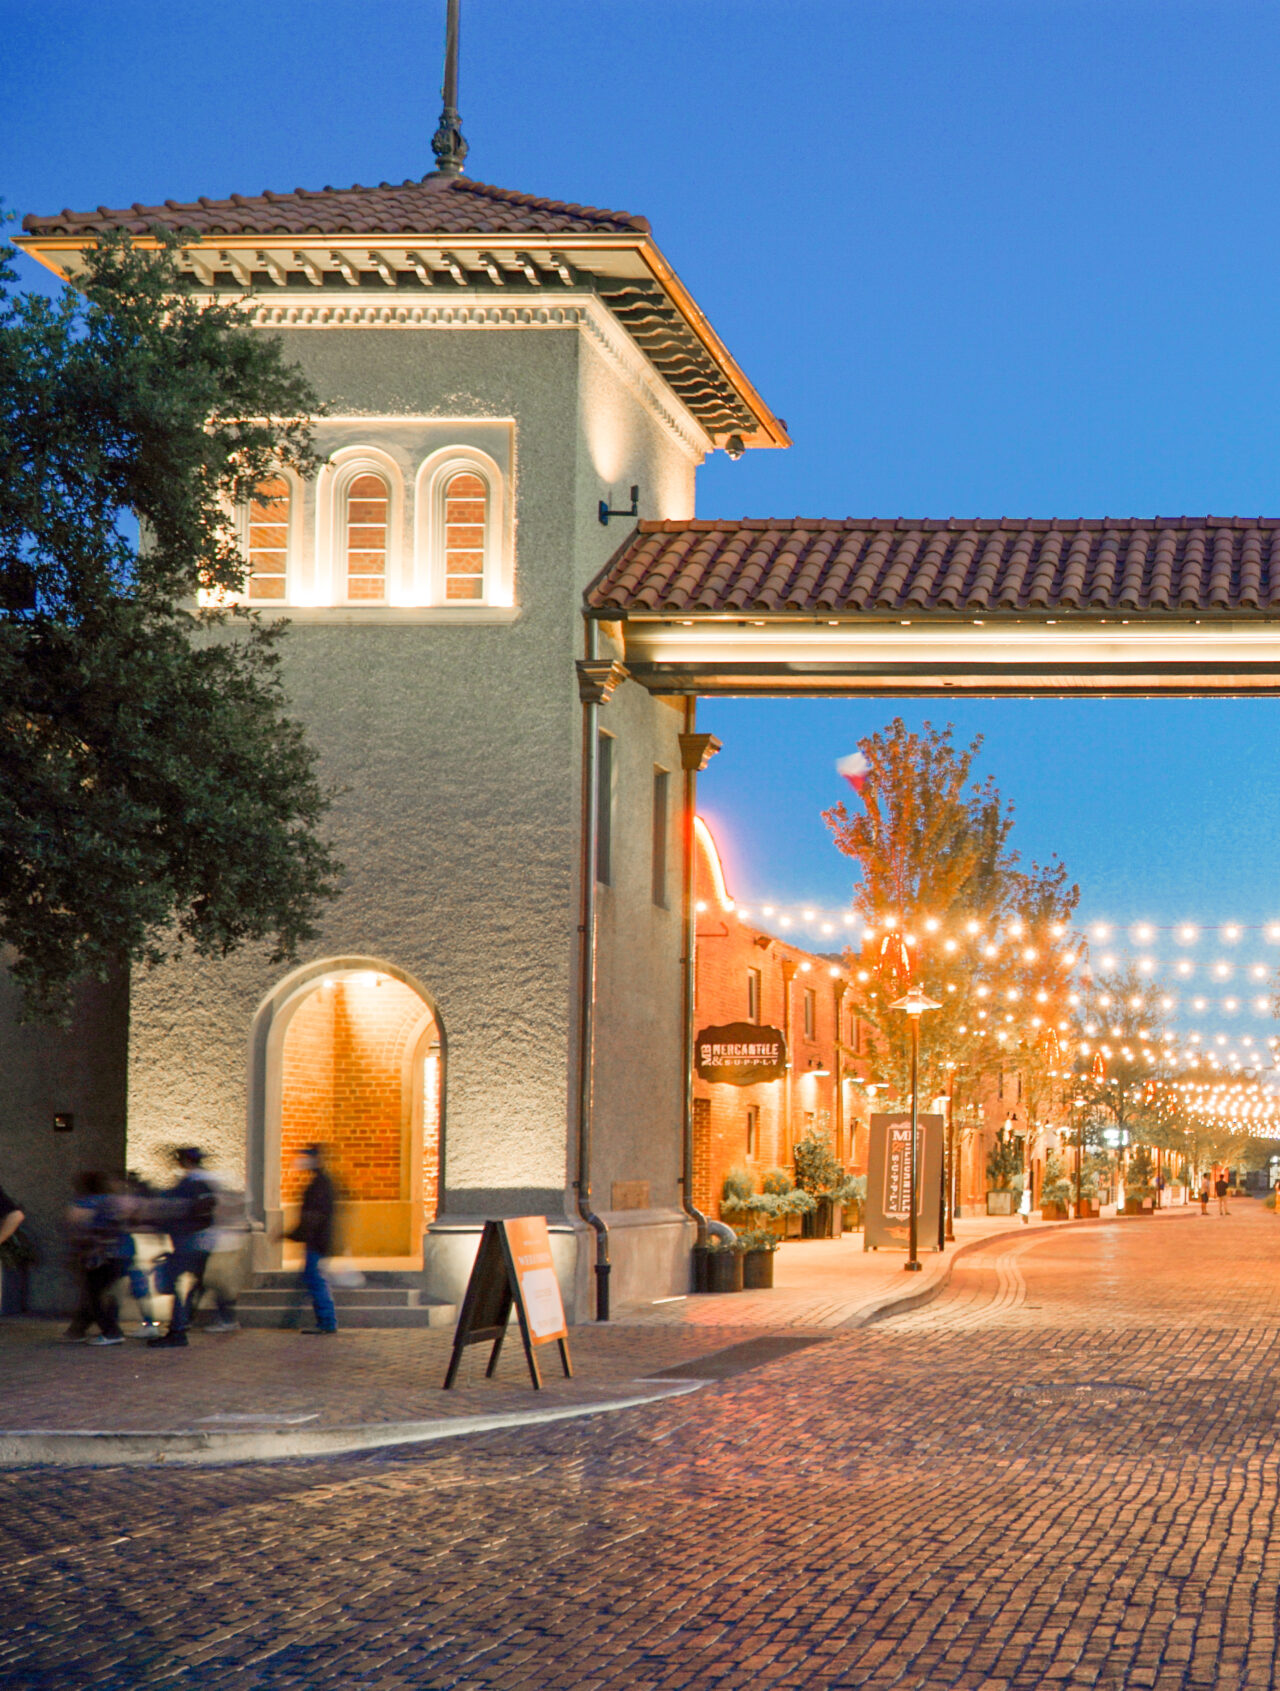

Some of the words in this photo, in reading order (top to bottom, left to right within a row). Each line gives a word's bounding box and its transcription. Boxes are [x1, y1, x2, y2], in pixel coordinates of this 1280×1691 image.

[701, 1044, 712, 1067] MB
[712, 1043, 779, 1056] MERCANTILE
[711, 1056, 722, 1066] &
